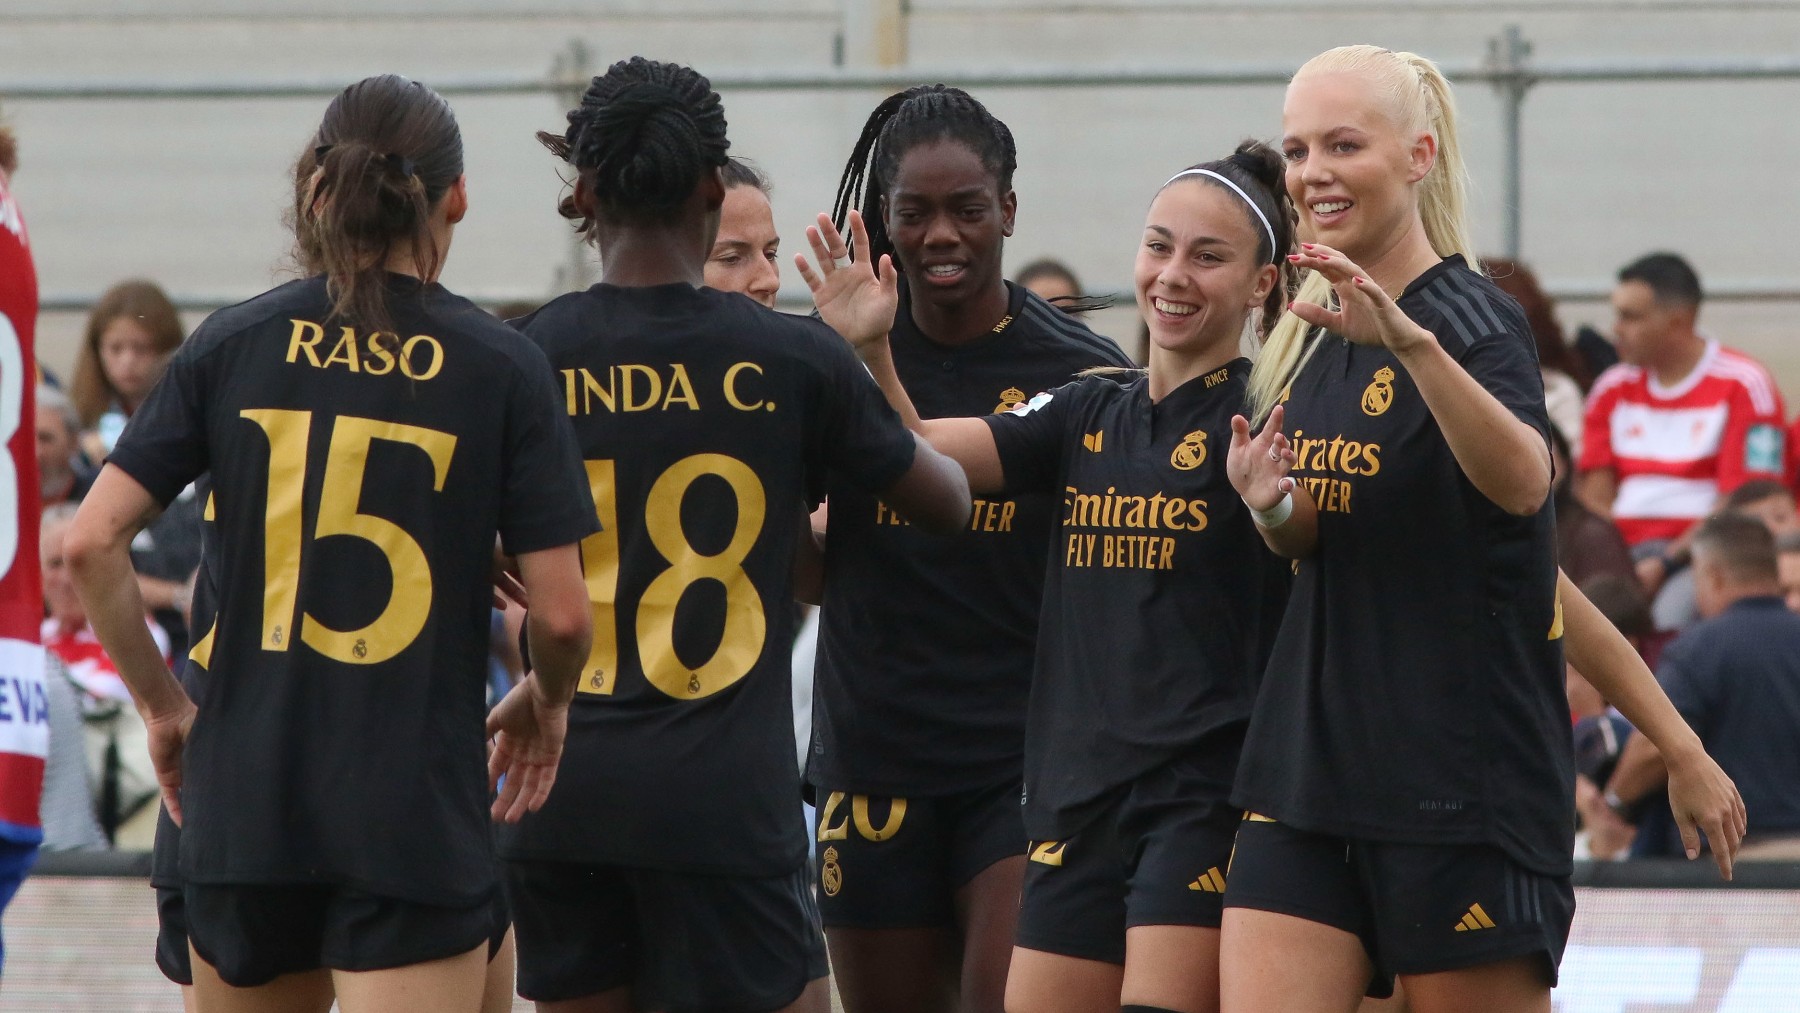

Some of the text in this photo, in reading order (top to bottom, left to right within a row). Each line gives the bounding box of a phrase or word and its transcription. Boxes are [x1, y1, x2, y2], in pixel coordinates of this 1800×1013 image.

[286, 319, 444, 381] RASO
[560, 361, 776, 416] INDA C.
[1292, 429, 1381, 477] irates
[876, 500, 1016, 532] FL TER
[1063, 486, 1209, 532] Emirates
[1296, 476, 1352, 514] TTER
[240, 408, 457, 665] 15
[1066, 534, 1176, 570] FLY BETTER
[577, 453, 766, 700] 18
